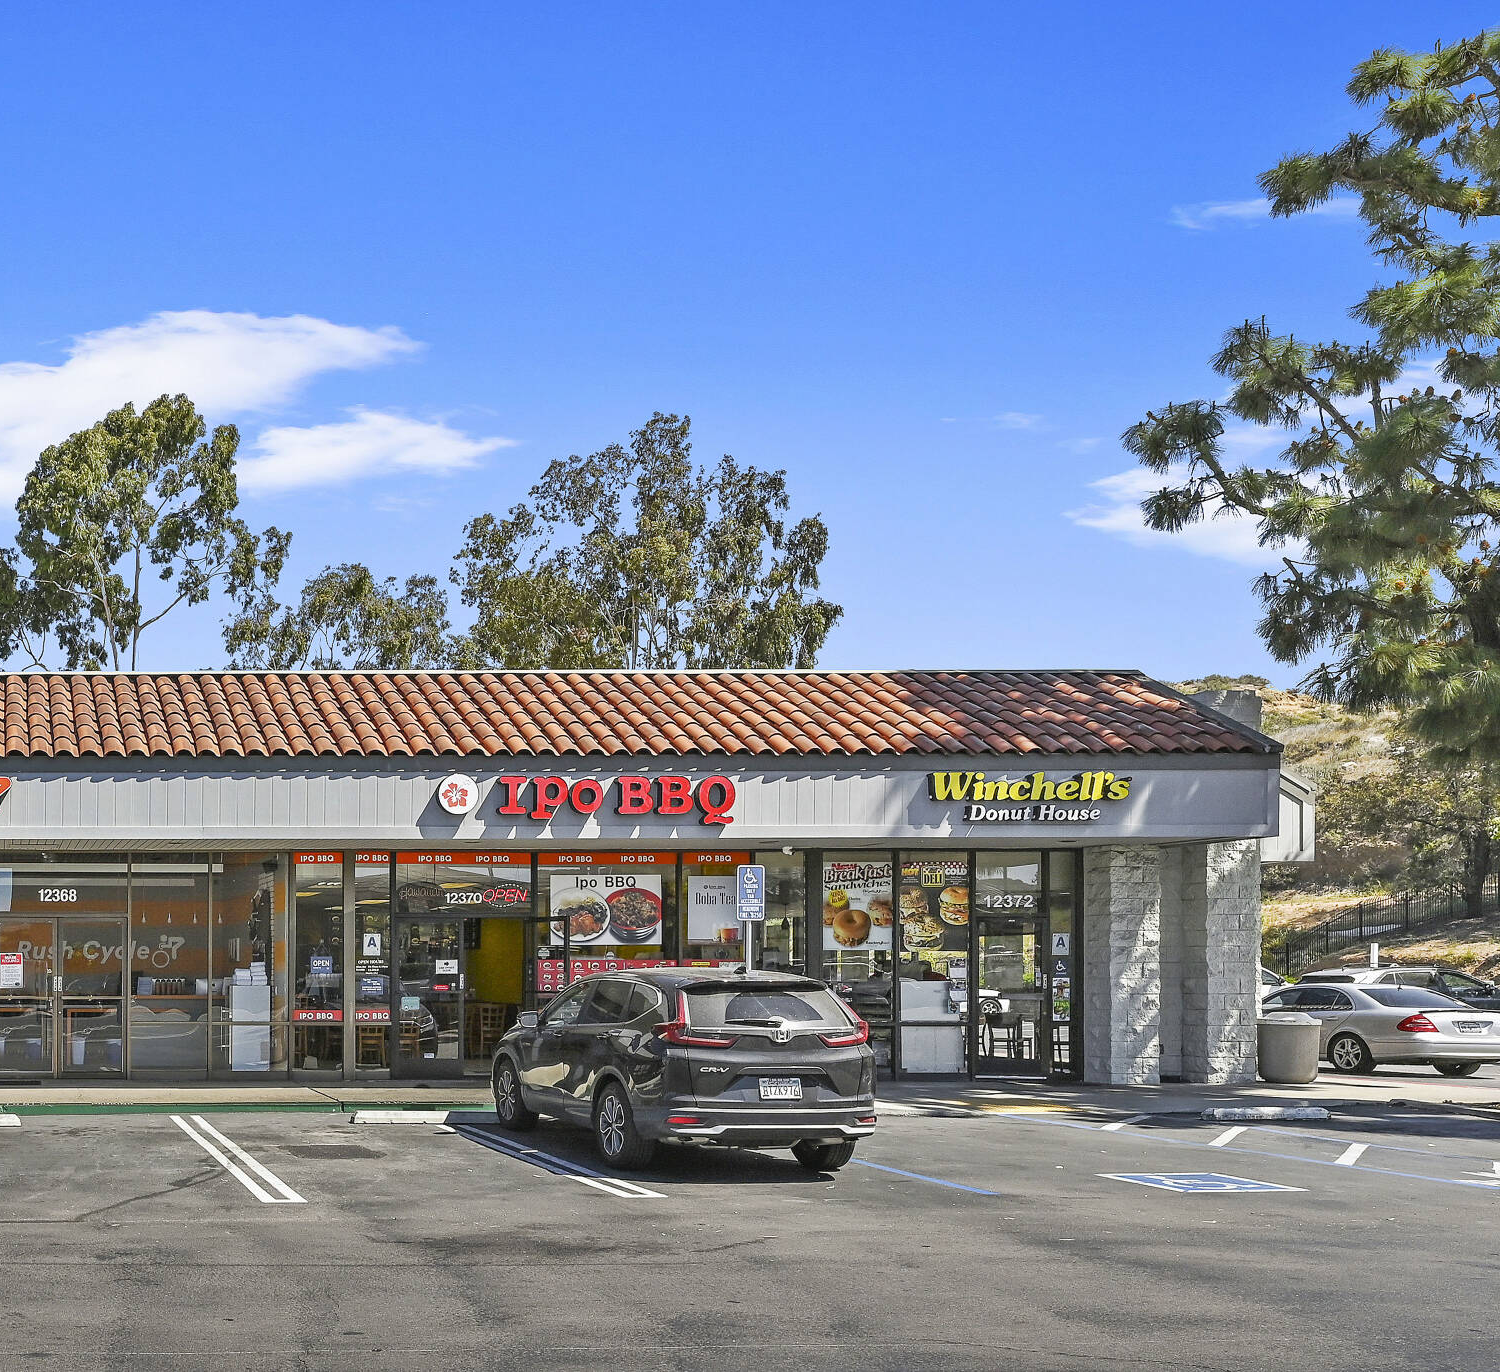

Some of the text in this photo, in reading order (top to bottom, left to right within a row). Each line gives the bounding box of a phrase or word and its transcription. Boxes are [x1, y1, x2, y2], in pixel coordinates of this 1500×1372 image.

[931, 770, 1132, 801] Winchell's
[616, 775, 736, 825] BBQ
[967, 804, 1101, 821] Donut House
[355, 854, 370, 862] IPO
[824, 865, 892, 883] Breakfast
[923, 873, 942, 884] DELI
[575, 876, 636, 890] Ipo BBQ
[38, 888, 77, 902] 12368
[444, 892, 483, 904] 12370
[482, 889, 528, 902] OPEN
[719, 892, 736, 905] Tea
[984, 895, 1034, 908] 12372
[367, 936, 377, 947] A
[1056, 936, 1065, 947] A
[18, 940, 149, 964] Rush Cycle
